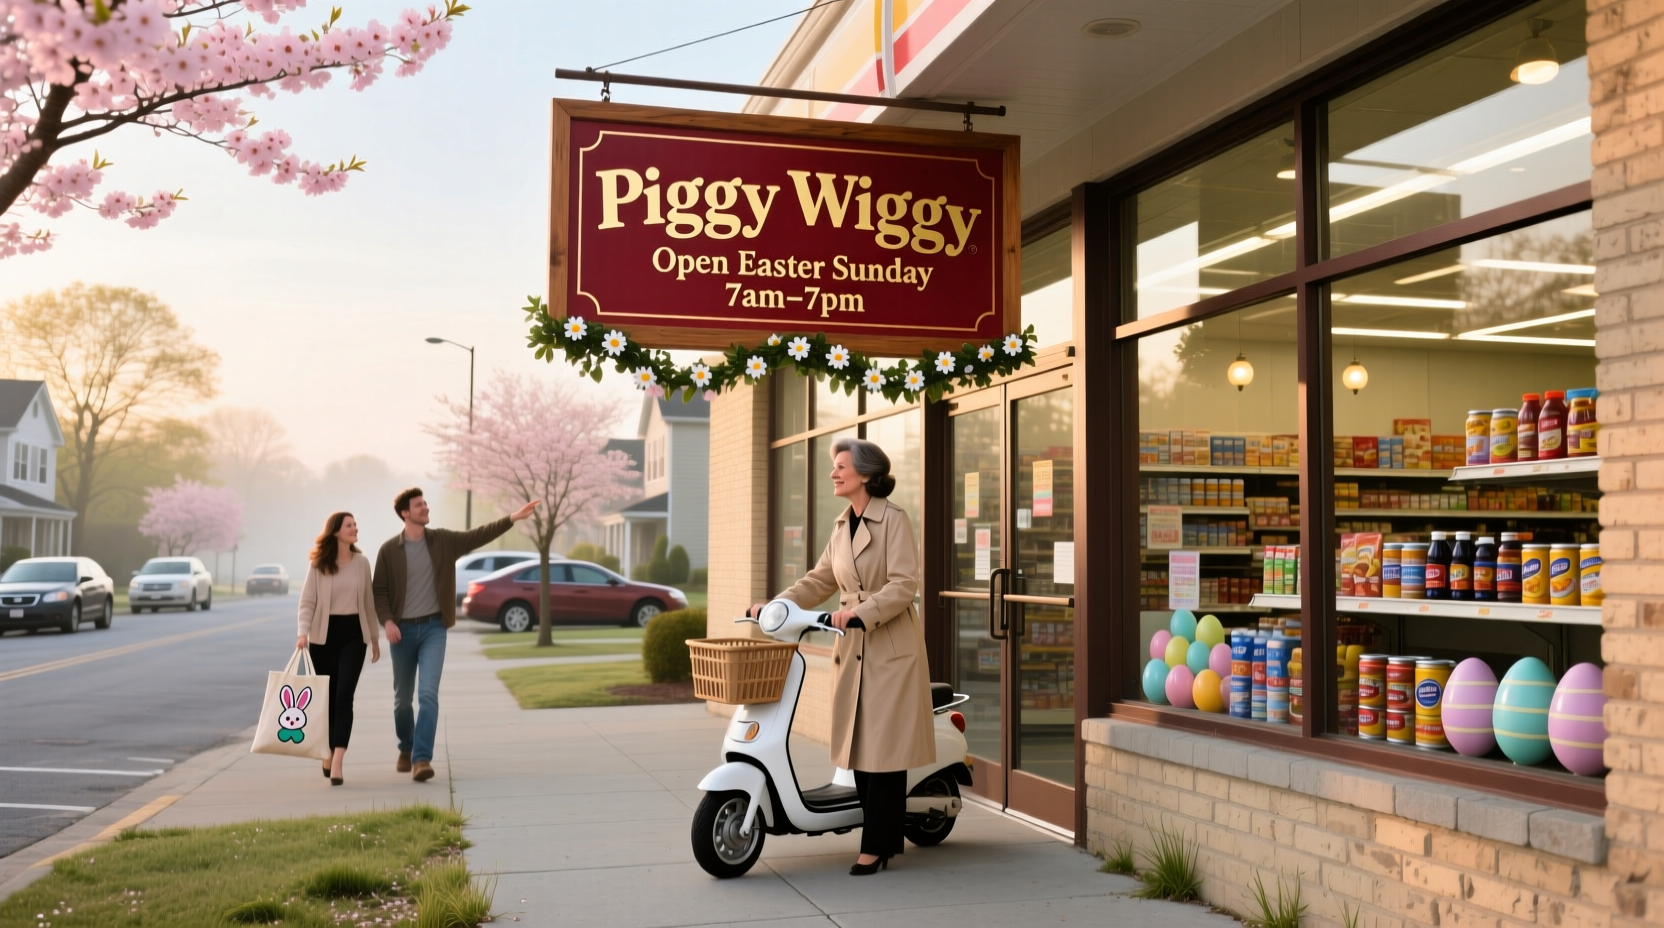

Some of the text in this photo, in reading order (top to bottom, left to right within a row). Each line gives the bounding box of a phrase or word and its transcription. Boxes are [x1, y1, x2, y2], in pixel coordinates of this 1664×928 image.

[596, 167, 982, 257] Piggy Wiggy
[652, 246, 934, 292] Open Easter Sunday
